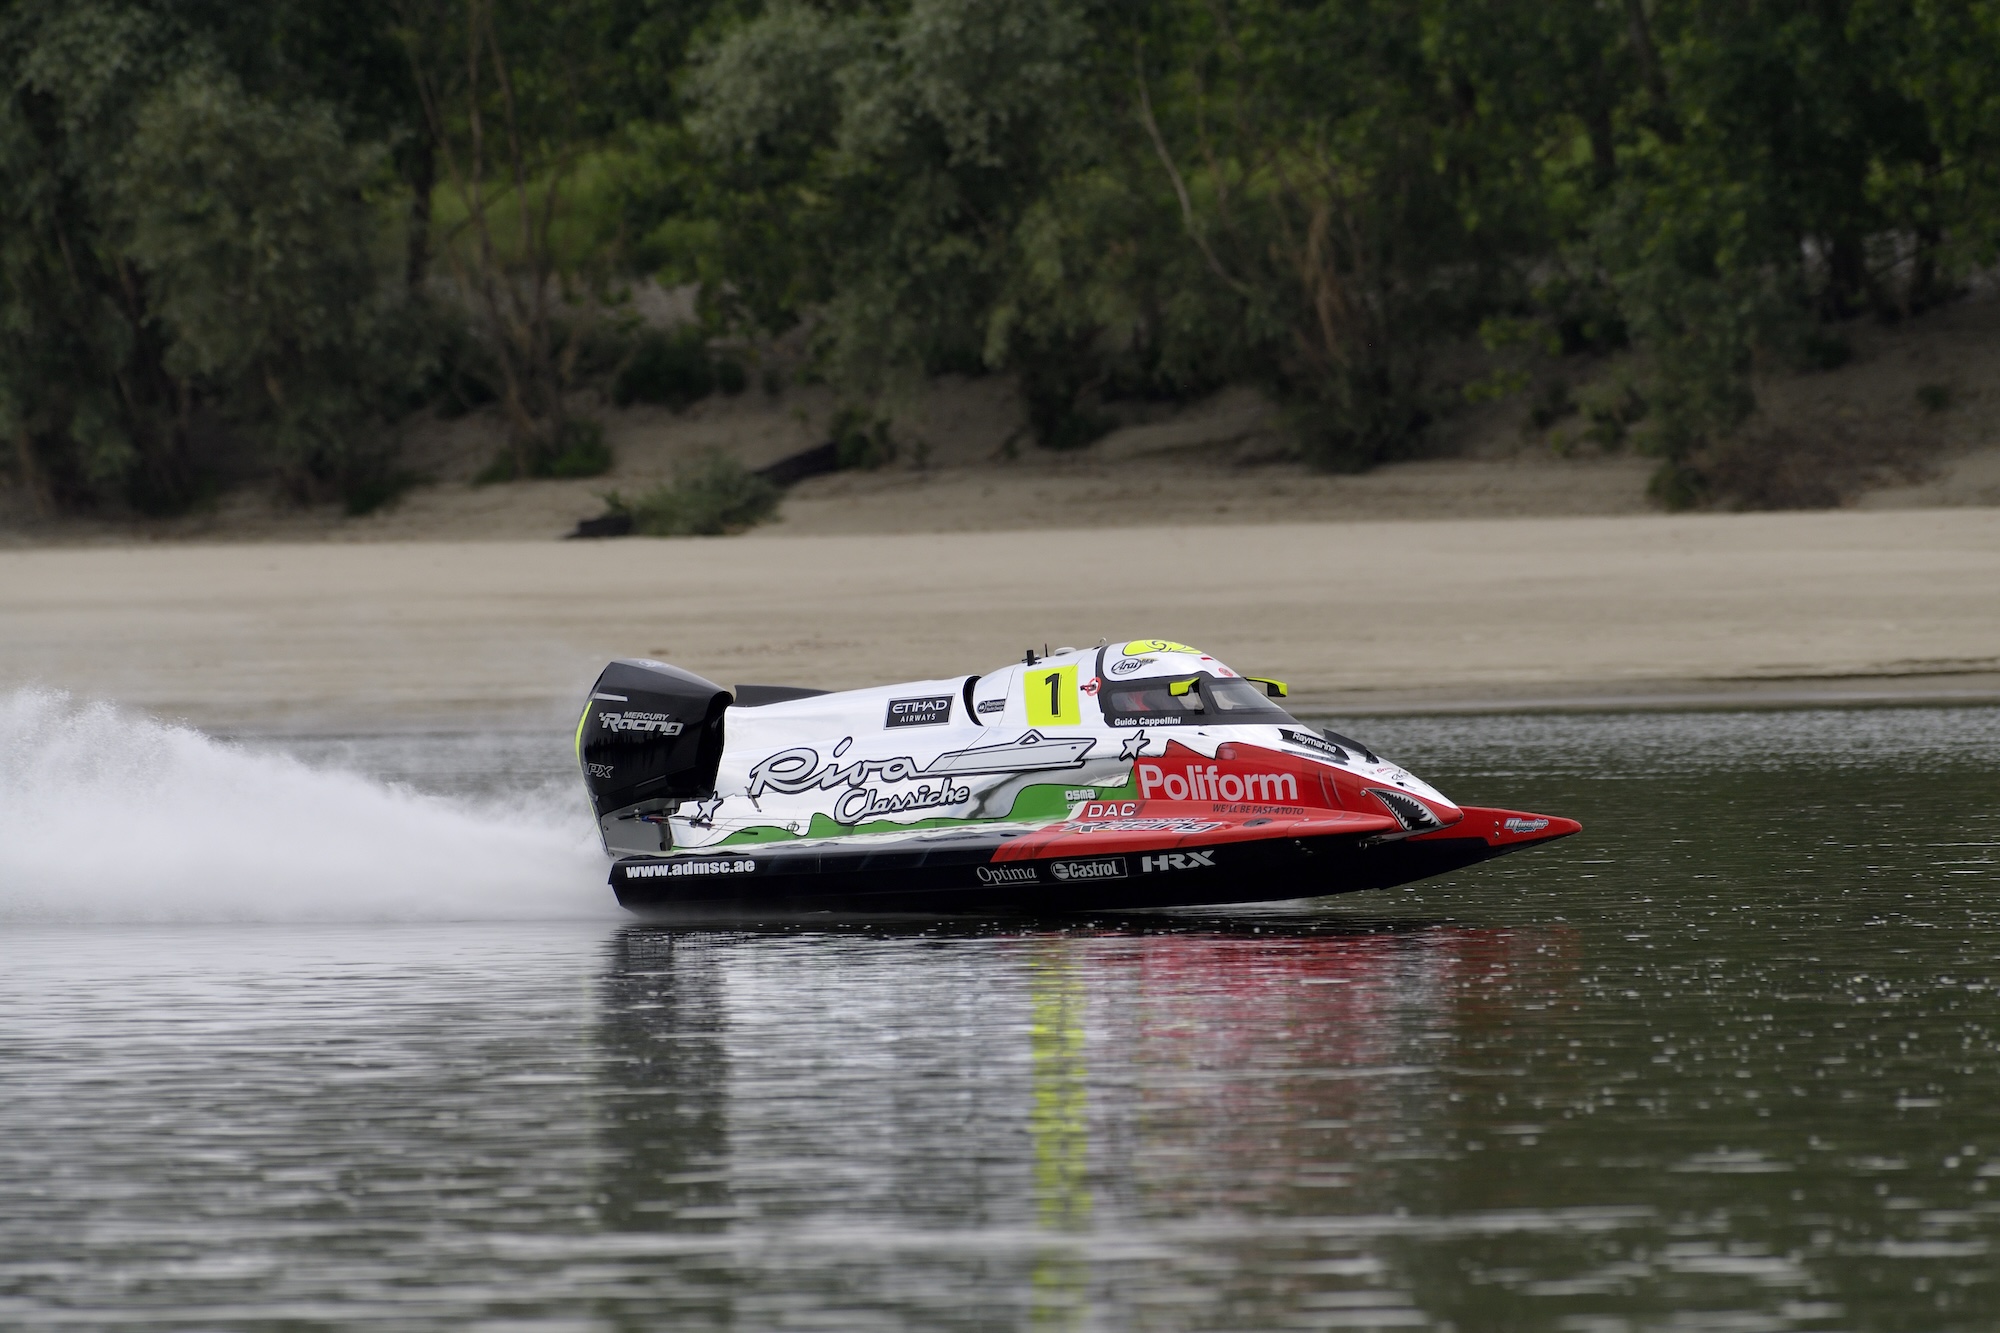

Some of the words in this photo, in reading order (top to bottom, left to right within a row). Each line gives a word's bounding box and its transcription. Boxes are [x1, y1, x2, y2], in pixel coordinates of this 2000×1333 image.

[1045, 673, 1062, 717] 1
[623, 711, 669, 721] MERCURY
[892, 700, 947, 714] ETIHAD
[599, 712, 684, 736] Racing
[900, 713, 936, 723] AIRWAYS
[1114, 717, 1137, 727] Guido
[1139, 716, 1181, 727] Cappellini
[1292, 732, 1337, 753] Raymarine
[750, 736, 920, 798] Riva
[1138, 764, 1299, 801] Poliform
[834, 776, 970, 826] Classiche
[1088, 803, 1136, 818] DAC
[1212, 804, 1238, 813] WE'LL
[1240, 804, 1251, 813] BE
[626, 860, 755, 878] www.admsc.ae
[1069, 861, 1119, 878] Castrol
[1142, 850, 1216, 872] HRX
[976, 864, 1038, 884] Optima
